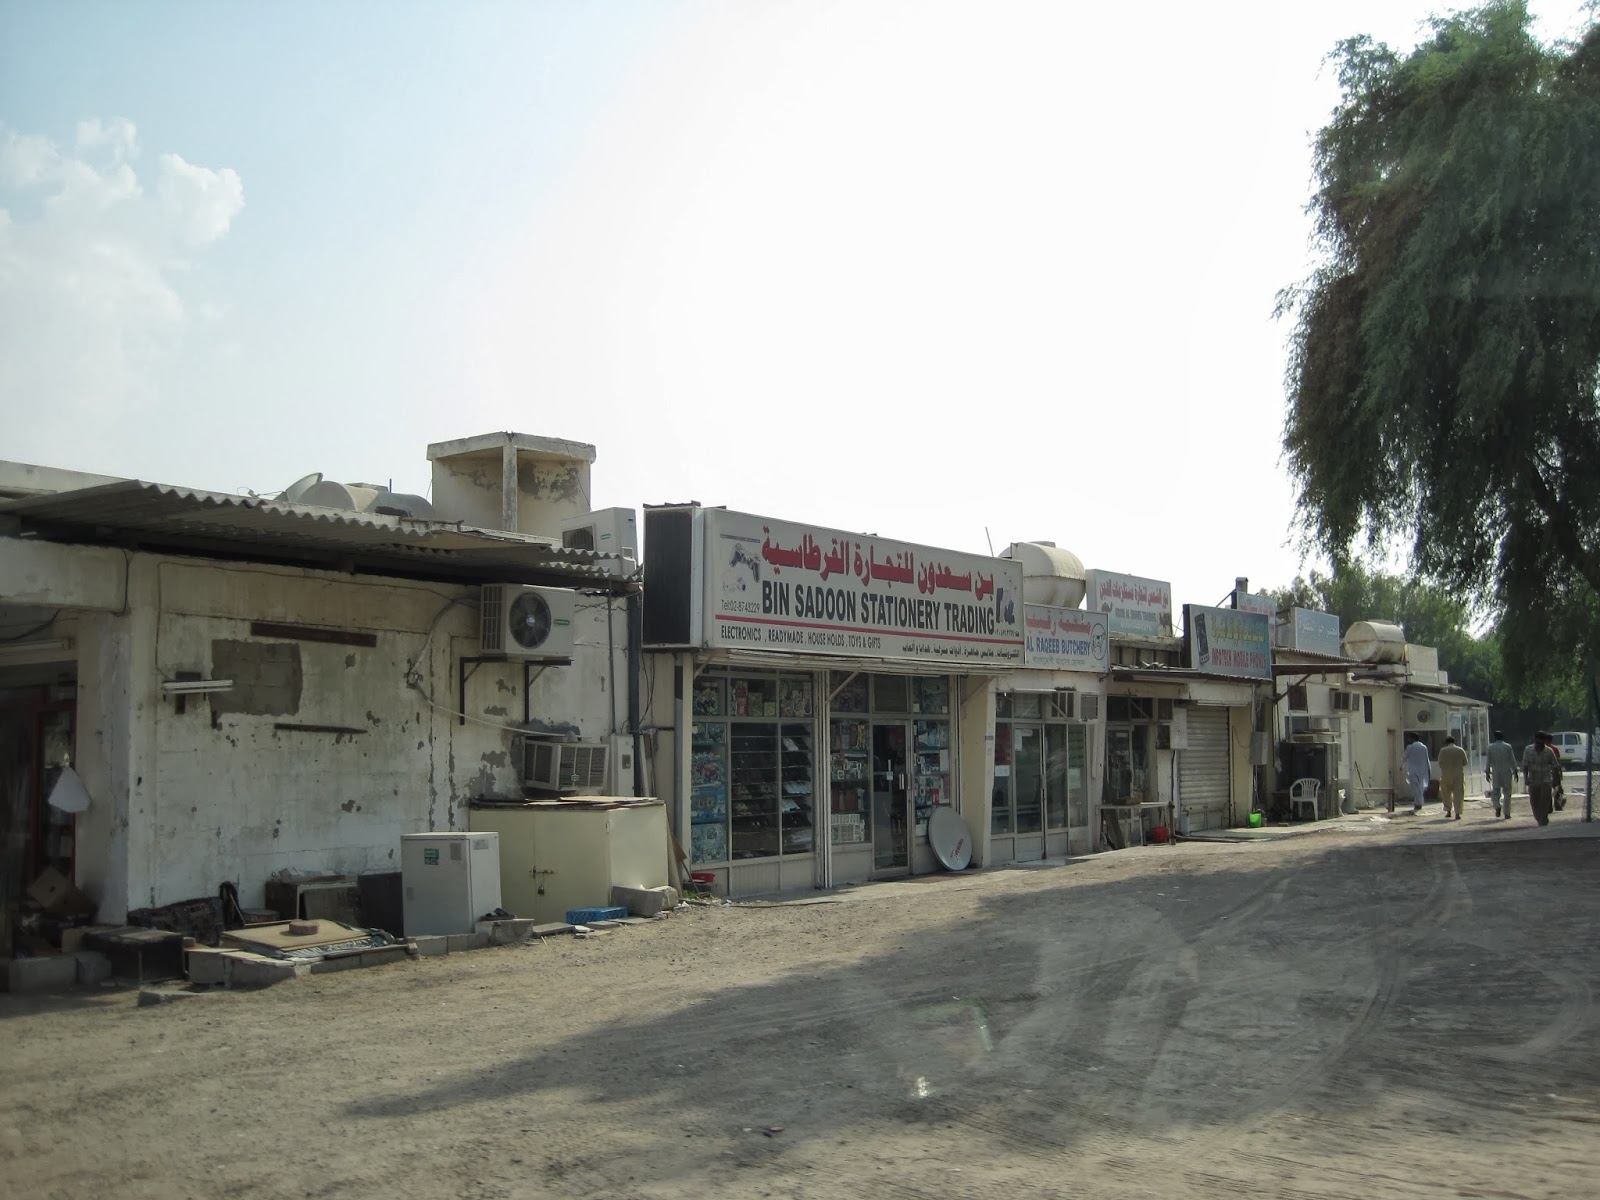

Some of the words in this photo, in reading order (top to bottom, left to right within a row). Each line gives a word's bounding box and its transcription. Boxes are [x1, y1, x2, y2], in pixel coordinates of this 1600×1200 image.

[762, 525, 850, 582] القرطاسية
[854, 543, 914, 588] للتجارة
[918, 561, 971, 595] سعدون
[975, 570, 994, 601] بن
[762, 580, 790, 616] BIN
[795, 583, 856, 623] SADOON
[861, 592, 941, 631] STATIONERY
[944, 602, 995, 635] TRADING
[721, 625, 761, 641] ELECTRONICS
[808, 631, 826, 646] HOUSE
[848, 634, 862, 648] TOYS
[868, 636, 881, 650] GIFTS
[1026, 636, 1034, 652] AL
[1036, 637, 1060, 654] RAQEEB
[1062, 639, 1091, 656] BUTCHERY
